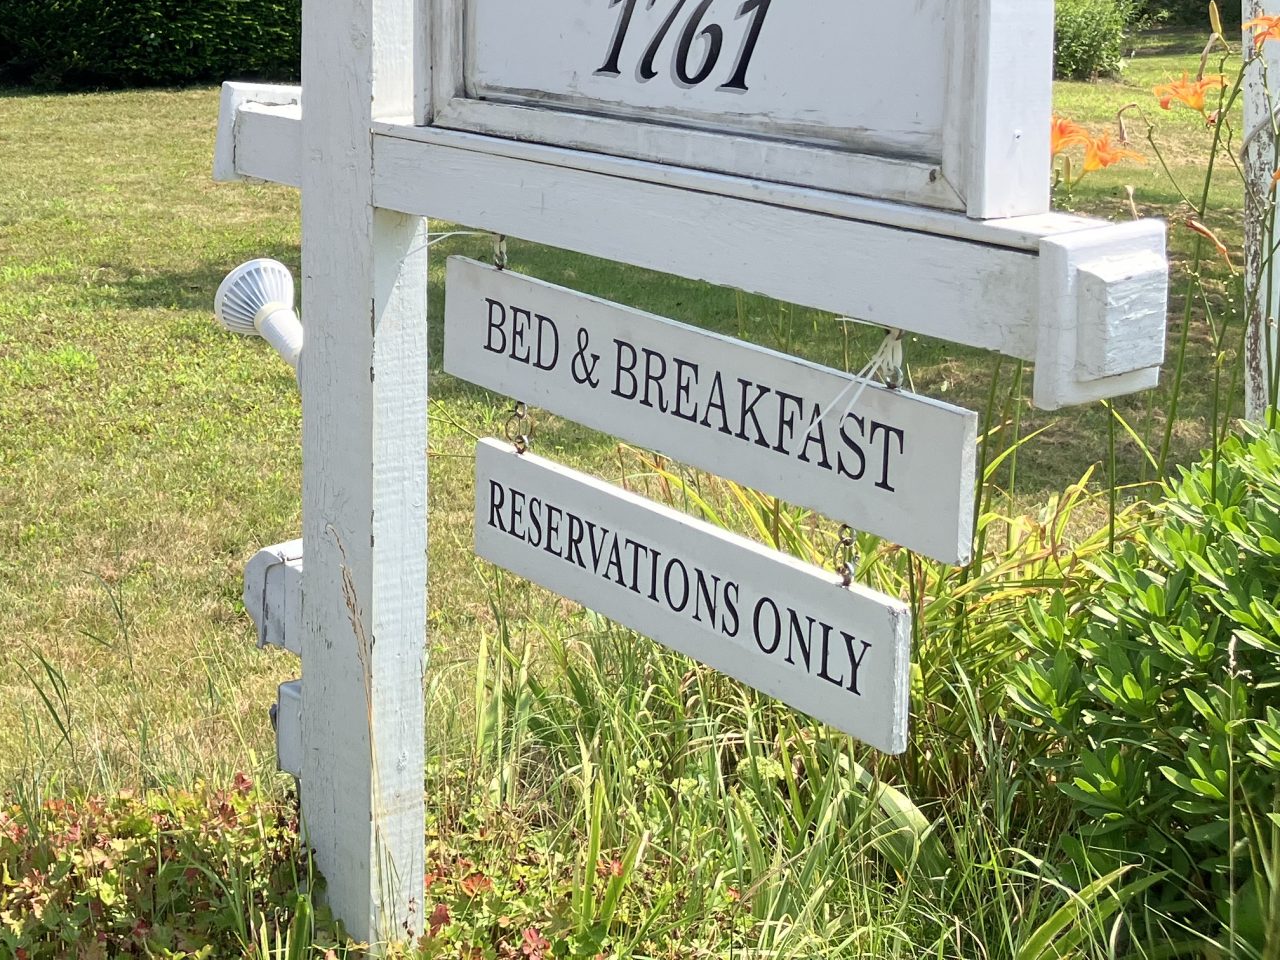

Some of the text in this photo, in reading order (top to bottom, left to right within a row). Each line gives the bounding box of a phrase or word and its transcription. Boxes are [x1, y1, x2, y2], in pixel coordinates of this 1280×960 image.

[483, 297, 904, 493] BED & BREAKFAST
[487, 479, 872, 697] RESERVATIONS ONLY
